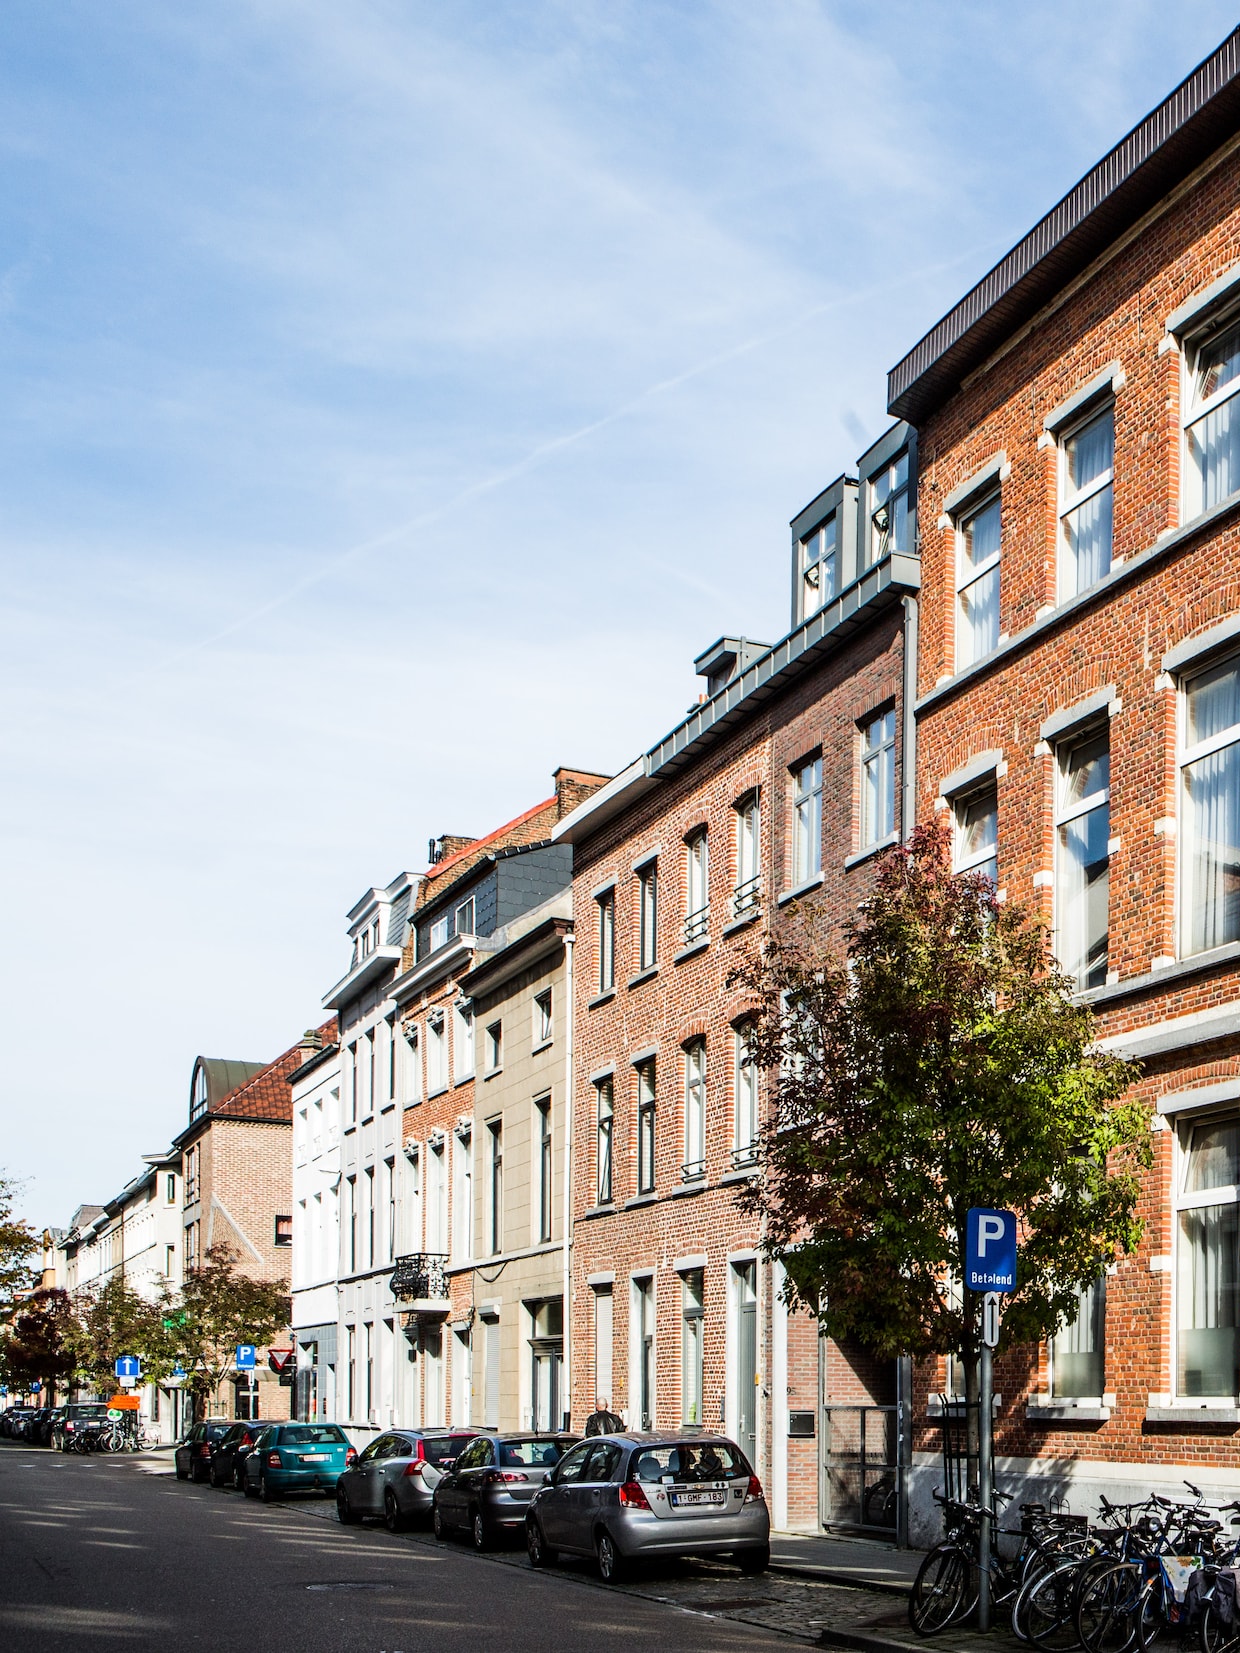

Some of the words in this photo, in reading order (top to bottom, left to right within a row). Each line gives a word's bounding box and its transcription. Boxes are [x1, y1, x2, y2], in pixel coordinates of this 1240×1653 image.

[978, 1215, 1005, 1257] P
[971, 1271, 1012, 1285] Betalend
[240, 1346, 251, 1360] P
